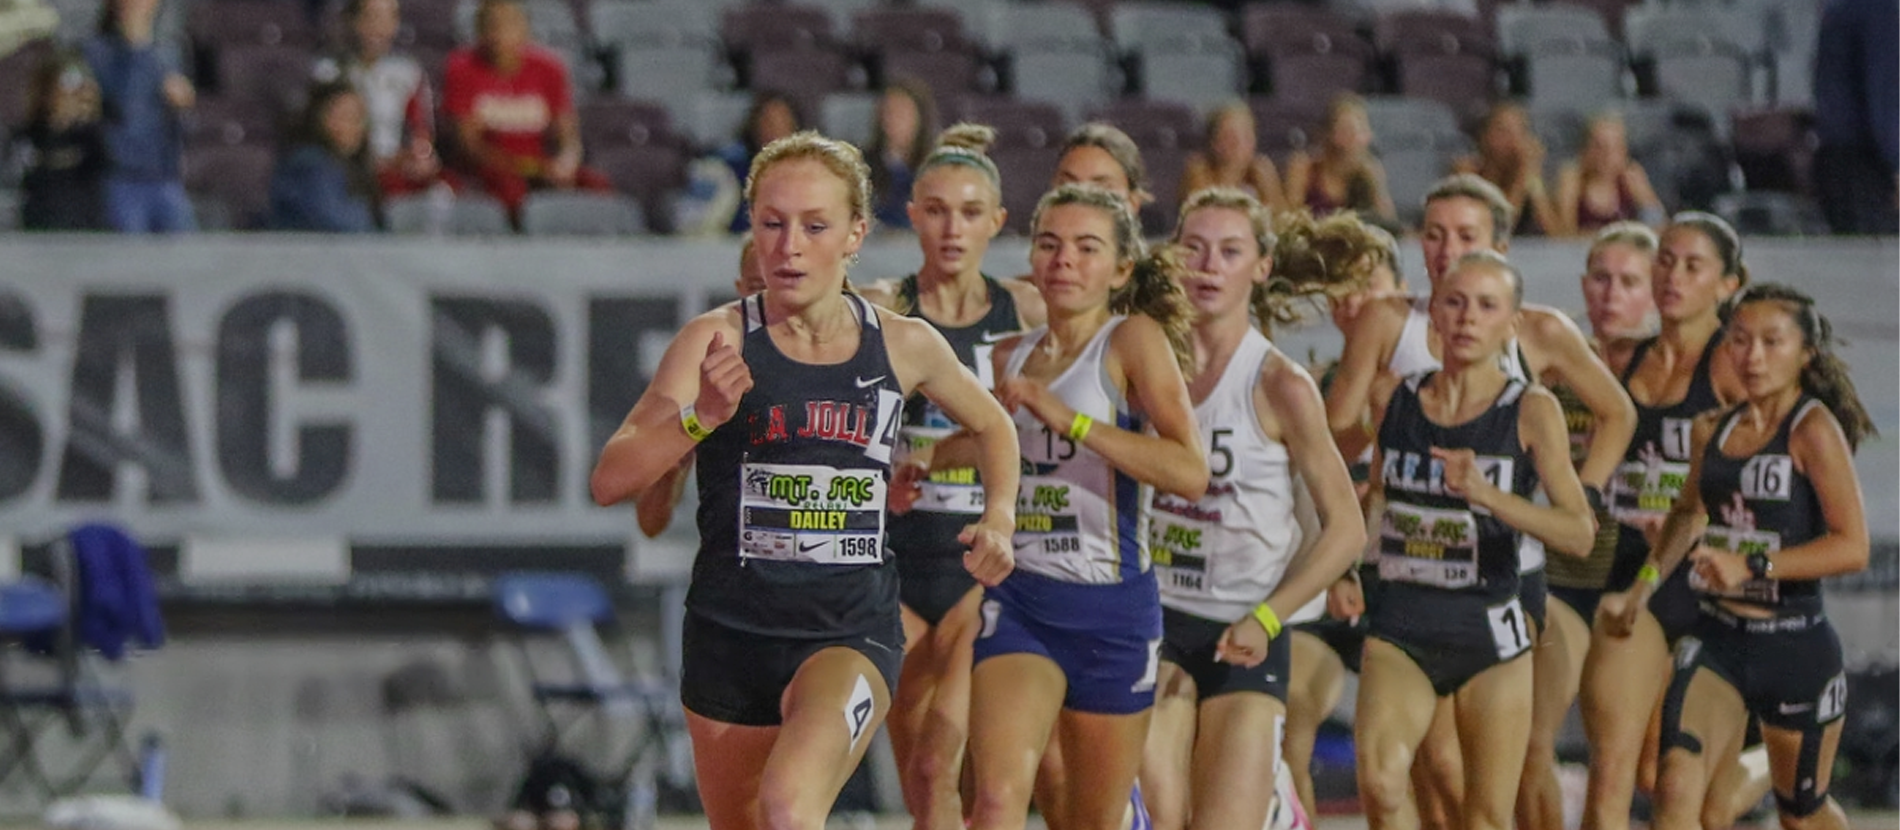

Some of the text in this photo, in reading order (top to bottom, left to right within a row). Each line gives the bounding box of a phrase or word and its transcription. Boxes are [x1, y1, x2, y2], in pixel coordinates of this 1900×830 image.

[425, 292, 705, 505] RE
[798, 401, 872, 448] JOLL
[880, 398, 901, 448] 4
[1210, 429, 1234, 477] 5
[770, 474, 874, 507] MT. SAC
[1752, 461, 1782, 496] 16
[790, 510, 847, 530] DAILEY
[838, 537, 878, 559] 1598
[1044, 536, 1080, 553] 1588
[1502, 608, 1522, 648] 1
[853, 697, 873, 739] 4
